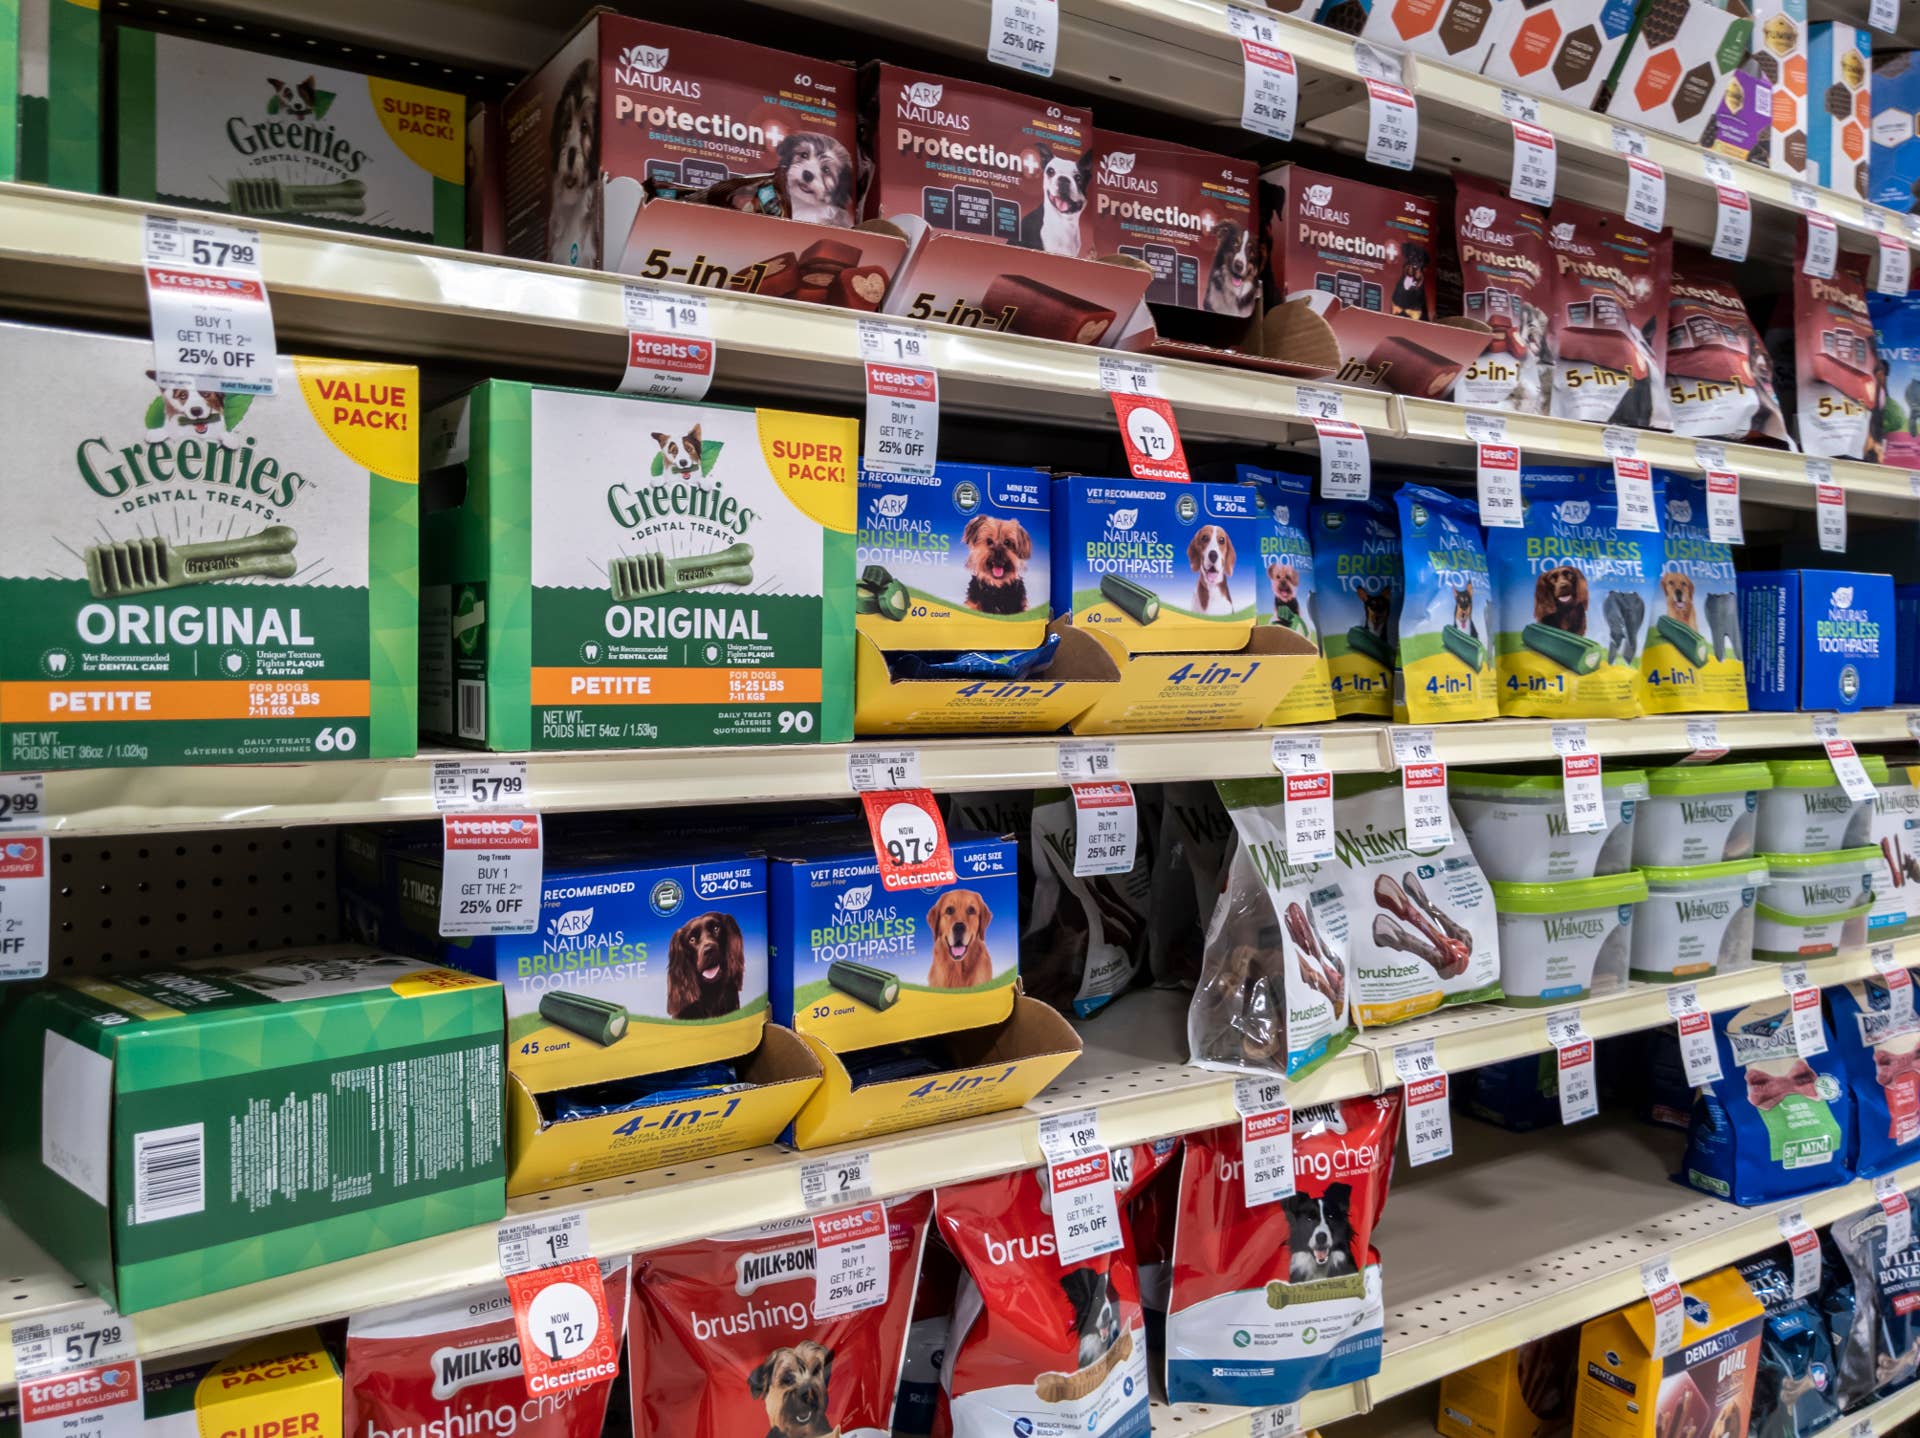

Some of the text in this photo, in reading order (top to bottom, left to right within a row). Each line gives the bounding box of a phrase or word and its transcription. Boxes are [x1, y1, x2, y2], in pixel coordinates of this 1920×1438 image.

[1002, 32, 1045, 54] 25% OFF
[634, 50, 664, 70] ARK
[615, 68, 701, 99] NATURALS
[912, 88, 940, 104] ARK
[384, 98, 451, 124] SUPER
[897, 103, 970, 131] NATURALS
[1254, 102, 1287, 121] 25% OFF
[398, 118, 454, 141] PACK!
[226, 115, 368, 173] Greenies
[1097, 172, 1158, 194] NATURALS
[1300, 202, 1350, 226] NATURALS
[1461, 224, 1514, 248] NATURALS
[641, 248, 768, 294] 5-in-1
[907, 292, 1018, 332] 5-in-1
[177, 330, 232, 346] GET THE
[179, 348, 255, 368] 25% OFF
[636, 338, 688, 359] treats
[872, 369, 914, 386] treats
[316, 378, 406, 408] VALUE
[1671, 376, 1745, 404] 5-in-1
[333, 406, 408, 432] PACK!
[880, 426, 912, 439] GET THE
[772, 440, 844, 464] SUPER
[878, 440, 924, 456] 25% OFF
[1483, 449, 1507, 462] treats
[76, 436, 306, 508] Greenies
[788, 462, 846, 483] PACK!
[868, 472, 942, 487] RECOMMENDED
[1132, 464, 1190, 480] Clearance
[1330, 472, 1362, 484] 25% OFF
[1086, 488, 1166, 500] VET RECOMMENDED
[122, 488, 275, 522] DENTAL TREATS
[607, 481, 756, 536] Greenies
[881, 500, 905, 512] ARK
[636, 521, 736, 546] DENTAL TREATS
[866, 516, 932, 534] NATURALS
[1552, 524, 1618, 542] NATURALS
[1104, 530, 1158, 544] NATURALS
[1086, 542, 1174, 560] BRUSHLESS
[1527, 538, 1642, 561] BRUSHLESS
[1086, 558, 1174, 575] TOOTHPASTE
[1528, 557, 1644, 578] TOOTHPASTE
[76, 603, 315, 646] ORIGINAL
[605, 605, 768, 640] ORIGINAL
[1817, 621, 1880, 638] BRUSHLESS
[1818, 638, 1880, 653] TOOTHPASTE
[729, 672, 778, 680] FOR DOGS
[1168, 662, 1261, 685] 4-in-1
[1332, 672, 1389, 692] 4-in-1
[1426, 673, 1472, 693] 4-in-1
[1506, 672, 1564, 692] 4-in-1
[248, 684, 310, 692] FOR DOGS
[571, 676, 652, 696] PETITE
[729, 680, 785, 692] 15-25 LBS
[956, 682, 1066, 698] 4-in-1
[48, 690, 152, 712] PETITE
[249, 692, 321, 706] 15-25 LBS
[248, 706, 296, 716] 7-11 KGS
[778, 710, 814, 734] 90
[12, 732, 62, 746] NET WT.
[244, 737, 312, 746] DAILY TREATS
[314, 726, 357, 753] 60
[12, 746, 50, 760] POIDS
[52, 746, 76, 760] NET
[78, 746, 104, 760] 36oz
[116, 744, 148, 760] 1.02kg
[1566, 758, 1590, 768] treats
[1290, 778, 1318, 791] treats
[1681, 801, 1733, 824] WHIMZEES
[454, 820, 510, 835] treats
[1296, 830, 1326, 842] 25% OFF
[964, 852, 1002, 862] LARGE SIZE
[1088, 845, 1126, 859] 25% OFF
[700, 868, 752, 882] MEDIUM SIZE
[886, 870, 954, 888] Clearance
[544, 882, 635, 901] RECOMMENDED
[845, 890, 870, 906] ARK
[460, 900, 523, 914] 25% OFF
[832, 906, 897, 928] NATURALS
[1676, 900, 1730, 923] WHIMZEES
[560, 914, 590, 931] ARK
[811, 917, 916, 948] BRUSHLESS
[1544, 918, 1604, 944] WHIMZEES
[544, 930, 624, 955] NATURALS
[811, 934, 916, 963] TOOTHPASTE
[518, 942, 648, 978] BRUSHLESS
[1358, 962, 1420, 978] brushzees
[518, 962, 648, 995] TOOTHPASTE
[812, 1005, 856, 1018] 30 count
[520, 1040, 570, 1056] 45 count
[1561, 1047, 1583, 1060] treats
[908, 1066, 1017, 1098] 4-in-1
[1566, 1089, 1589, 1104] 25% OFF
[612, 1098, 742, 1137] 4-in-1
[1248, 1115, 1277, 1132] treats
[1801, 1136, 1830, 1154] MINI
[1056, 1162, 1092, 1180] treats
[818, 1214, 863, 1234] treats
[1066, 1207, 1096, 1222] GET THE
[1068, 1216, 1108, 1238] 25% OFF
[830, 1279, 876, 1300] 25% OFF
[550, 1312, 570, 1325] NOW
[691, 1301, 810, 1341] brushing
[222, 1352, 310, 1376] SUPER
[222, 1358, 320, 1390] PACK!
[1718, 1348, 1748, 1383] DUAL
[530, 1361, 616, 1392] Clearance
[28, 1376, 102, 1403] treats
[32, 1389, 129, 1414] MEMBER EXCLUSIVE!
